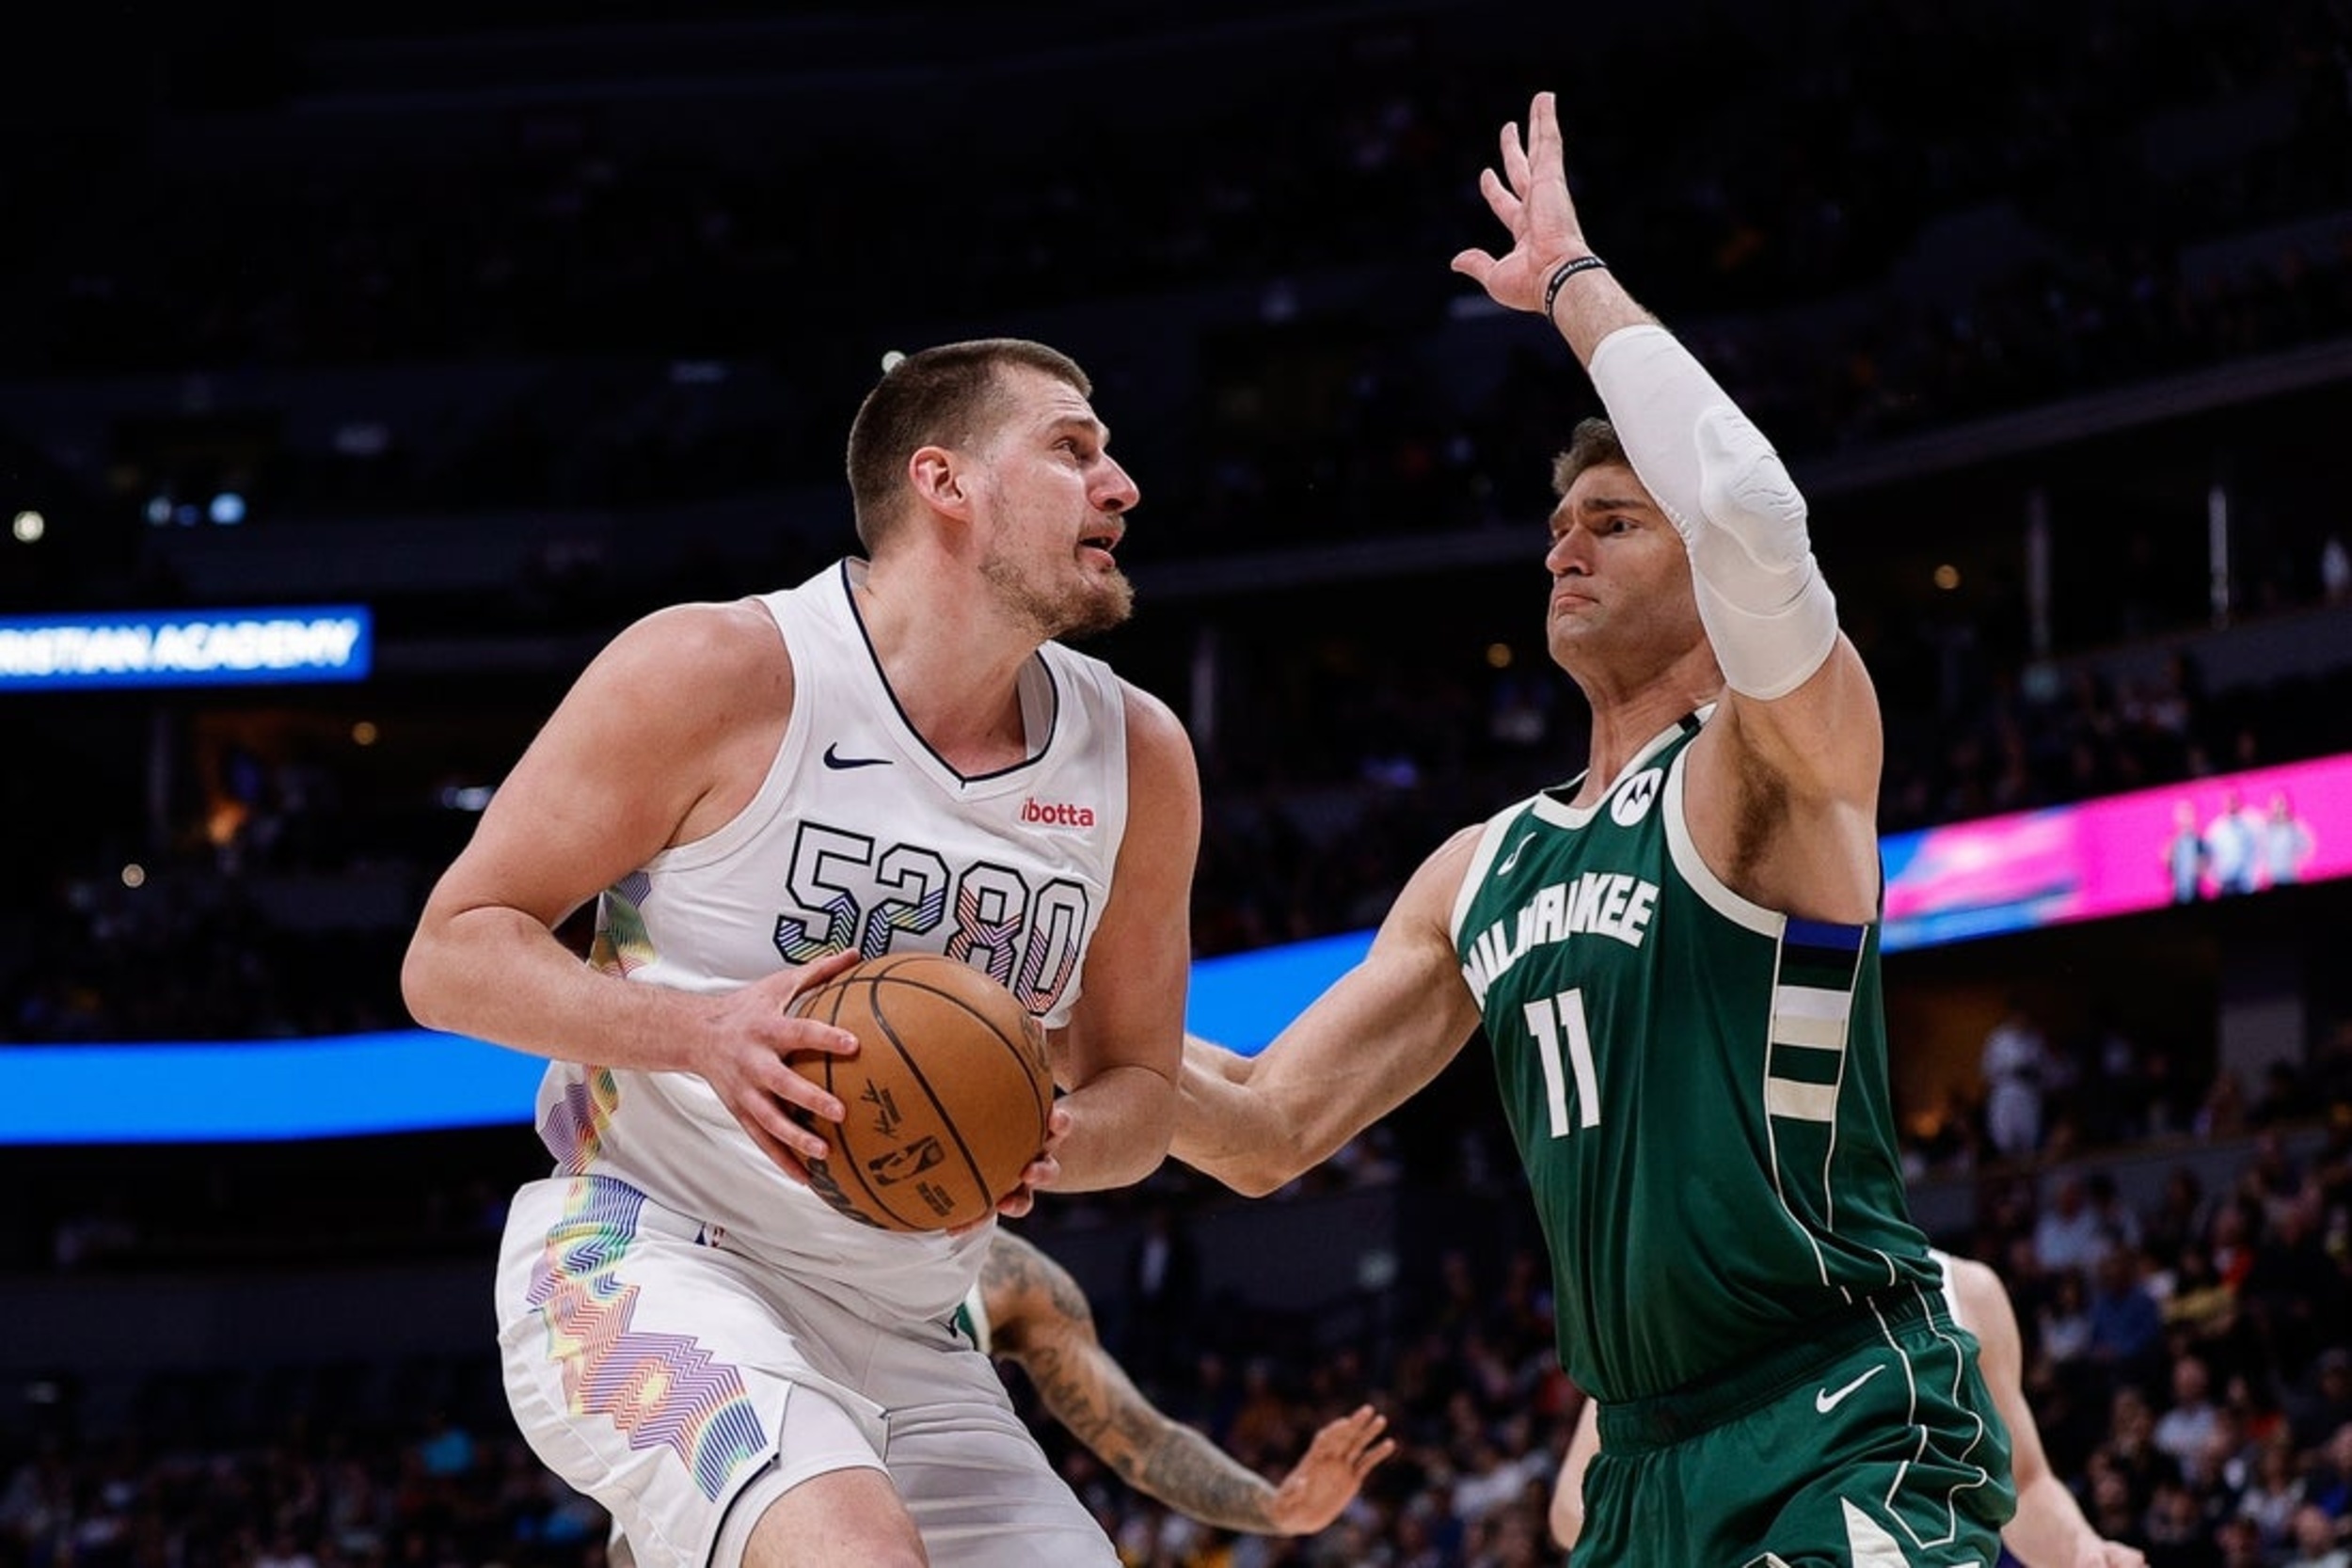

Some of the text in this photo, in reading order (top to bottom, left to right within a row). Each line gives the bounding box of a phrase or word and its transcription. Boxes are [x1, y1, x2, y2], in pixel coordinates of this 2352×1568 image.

[152, 618, 359, 672] ACADEMY
[1021, 797, 1094, 826] ibotta
[773, 819, 1089, 1017] 5280
[1522, 987, 1601, 1139] 11
